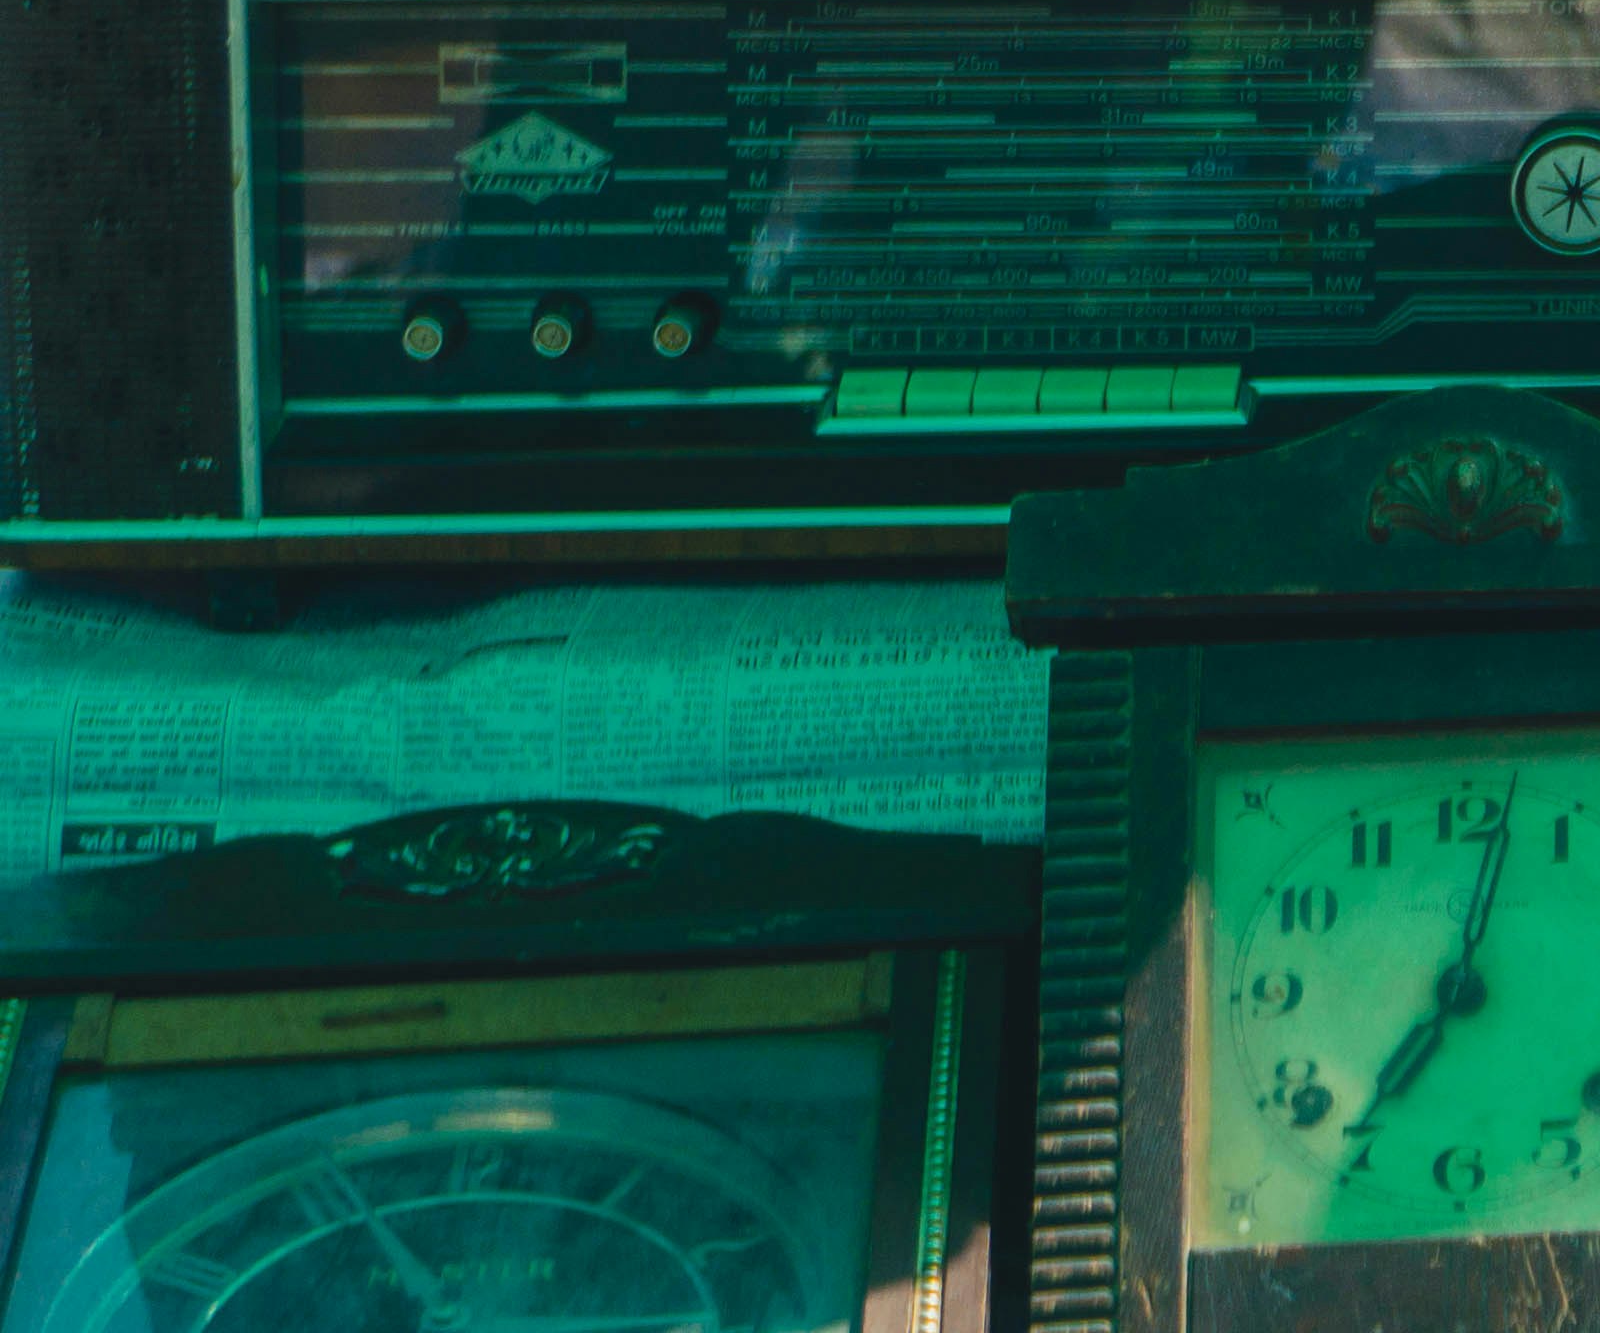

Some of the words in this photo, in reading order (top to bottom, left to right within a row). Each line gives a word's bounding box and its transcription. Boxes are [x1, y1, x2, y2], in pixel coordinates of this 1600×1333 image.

[1320, 35, 1365, 49] MC/S
[1320, 88, 1364, 102] MC/S
[1190, 159, 1234, 177] 49m
[653, 205, 689, 220] OFF
[698, 204, 727, 219] ON
[1235, 212, 1278, 230] 60m
[537, 220, 587, 237] BASS
[653, 220, 728, 236] VOLUME
[1210, 266, 1249, 282] 200
[1325, 275, 1362, 293] MW
[1434, 795, 1502, 845] 12
[1345, 819, 1393, 870] 11
[1551, 813, 1570, 865] 1
[1278, 883, 1340, 935] 10
[1250, 972, 1304, 1021] 9
[1530, 1117, 1584, 1169] 5
[1431, 1144, 1487, 1196] 6
